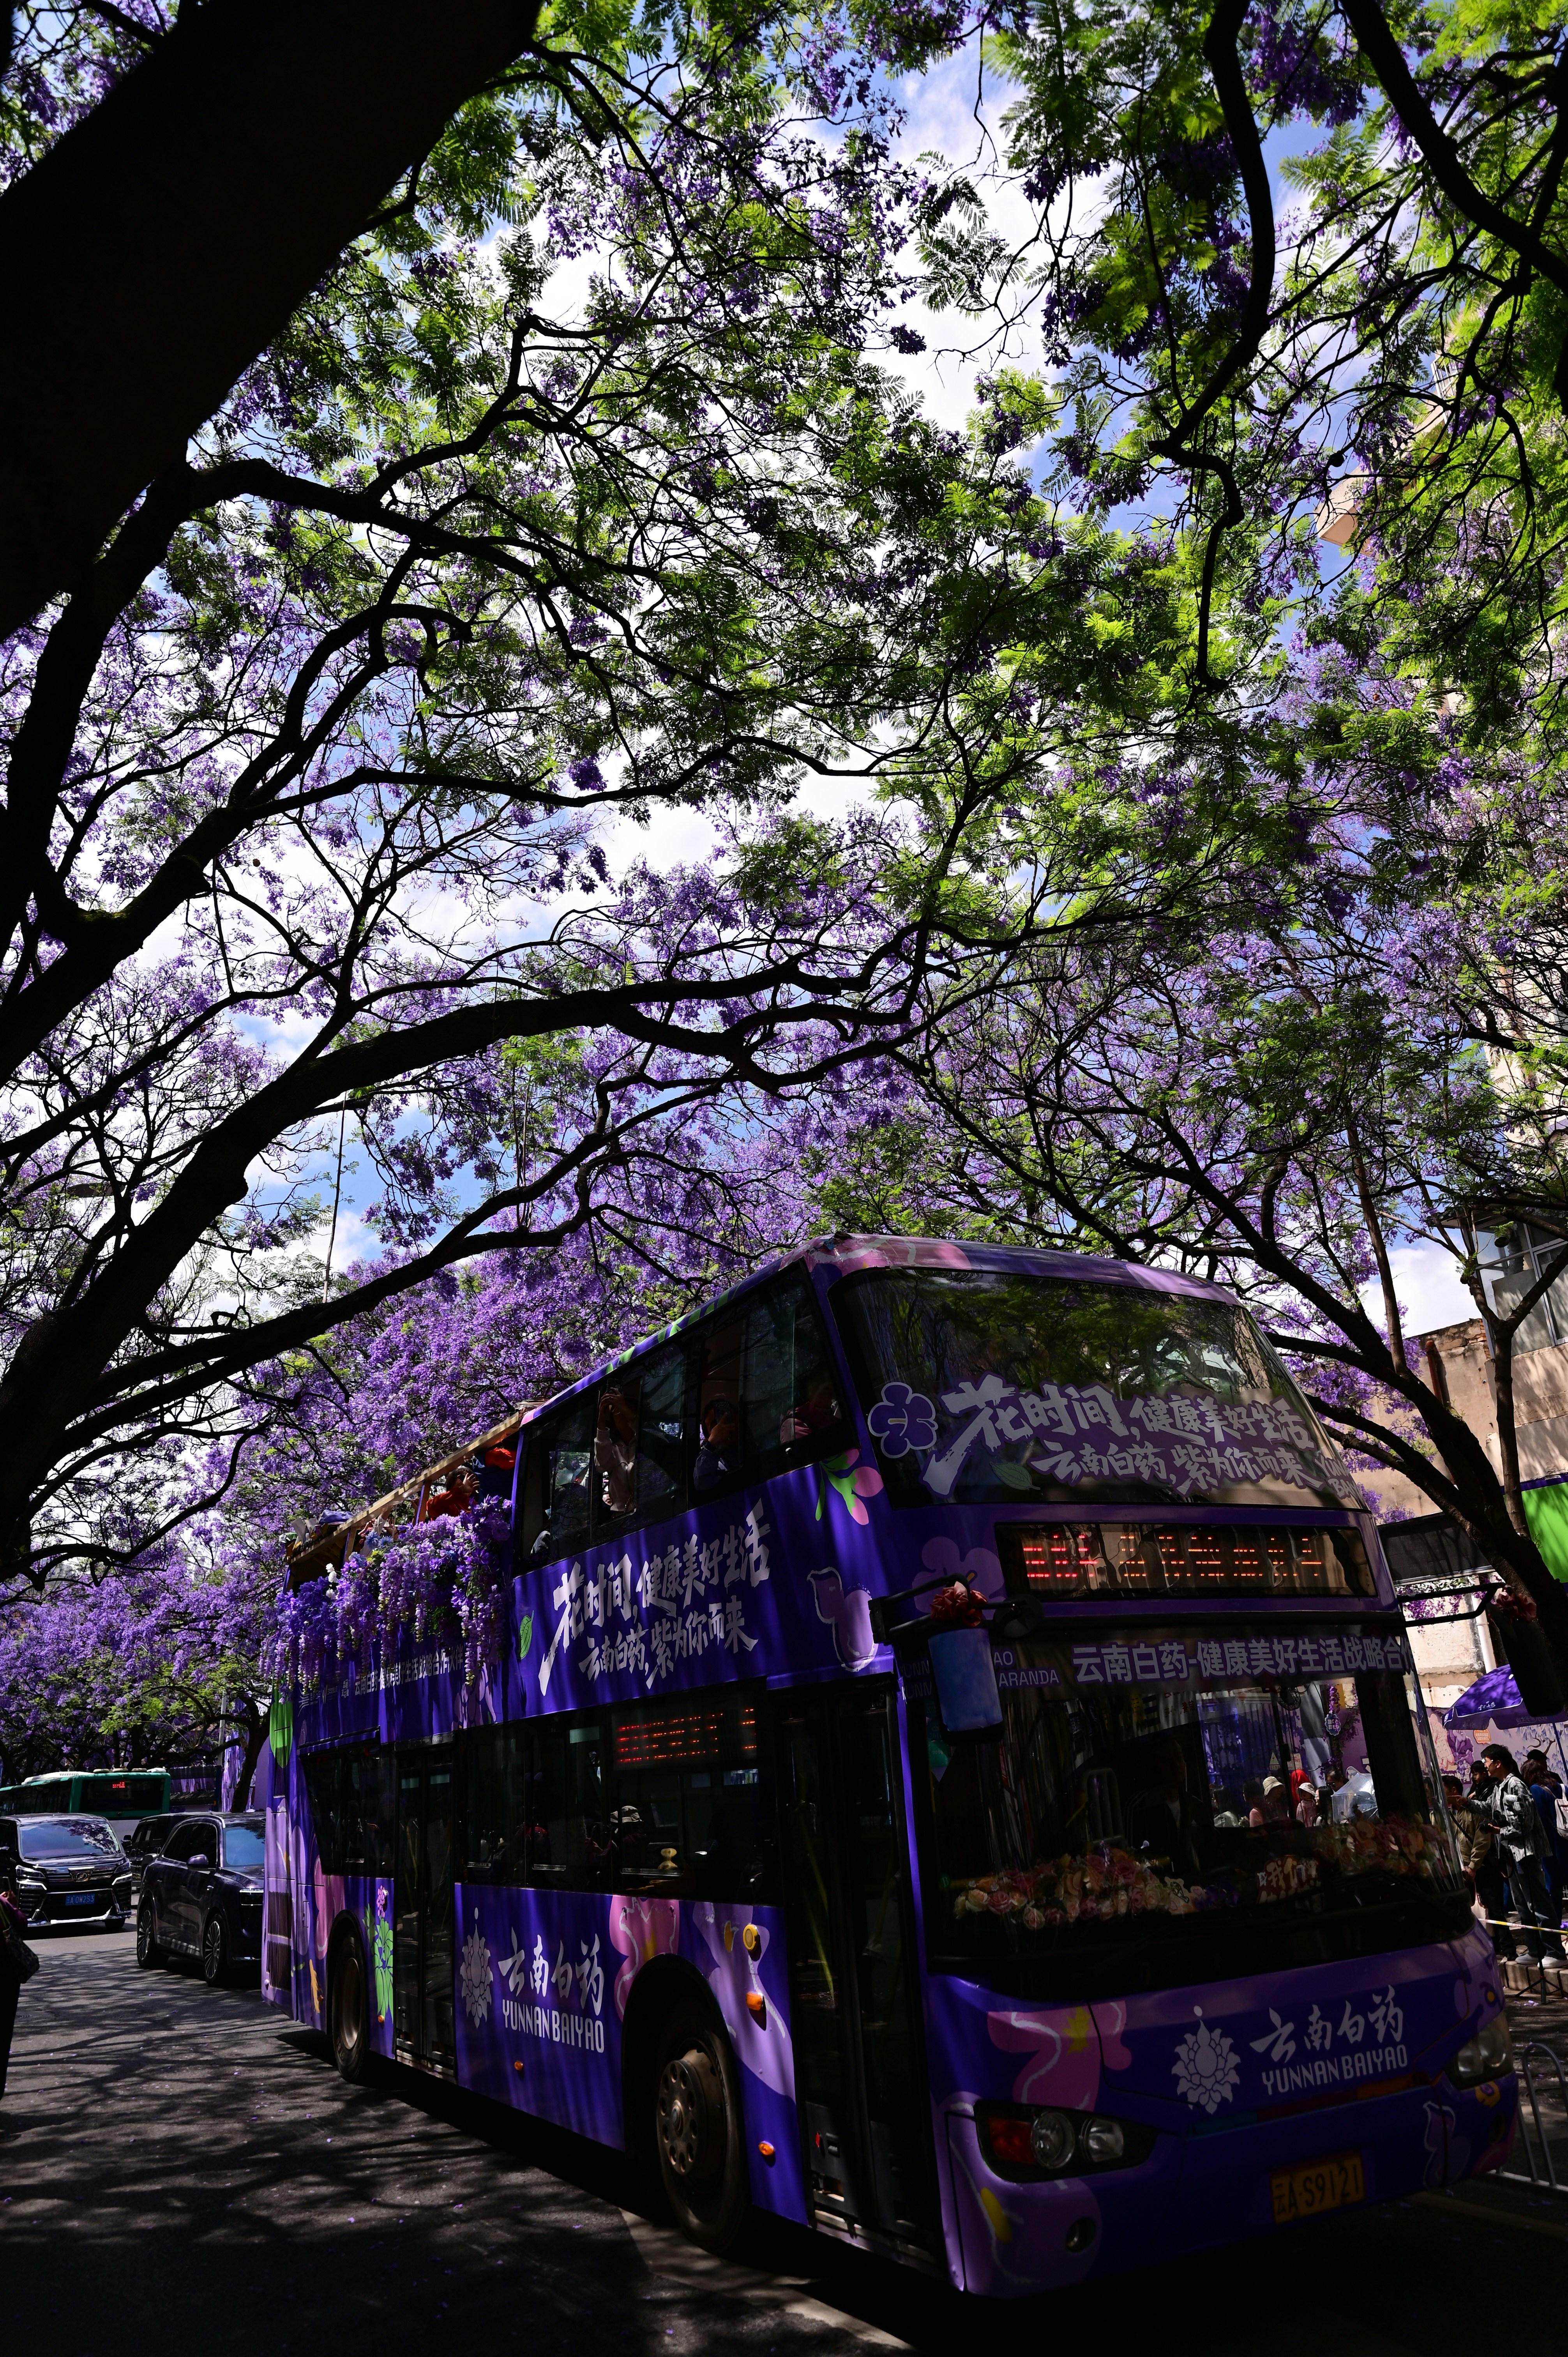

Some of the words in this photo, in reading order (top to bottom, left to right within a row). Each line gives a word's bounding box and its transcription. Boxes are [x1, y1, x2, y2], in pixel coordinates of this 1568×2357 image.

[998, 1669, 1059, 1687] ARANDA
[498, 1926, 605, 2016] 云南白药
[1249, 1984, 1403, 2064] 云南白药
